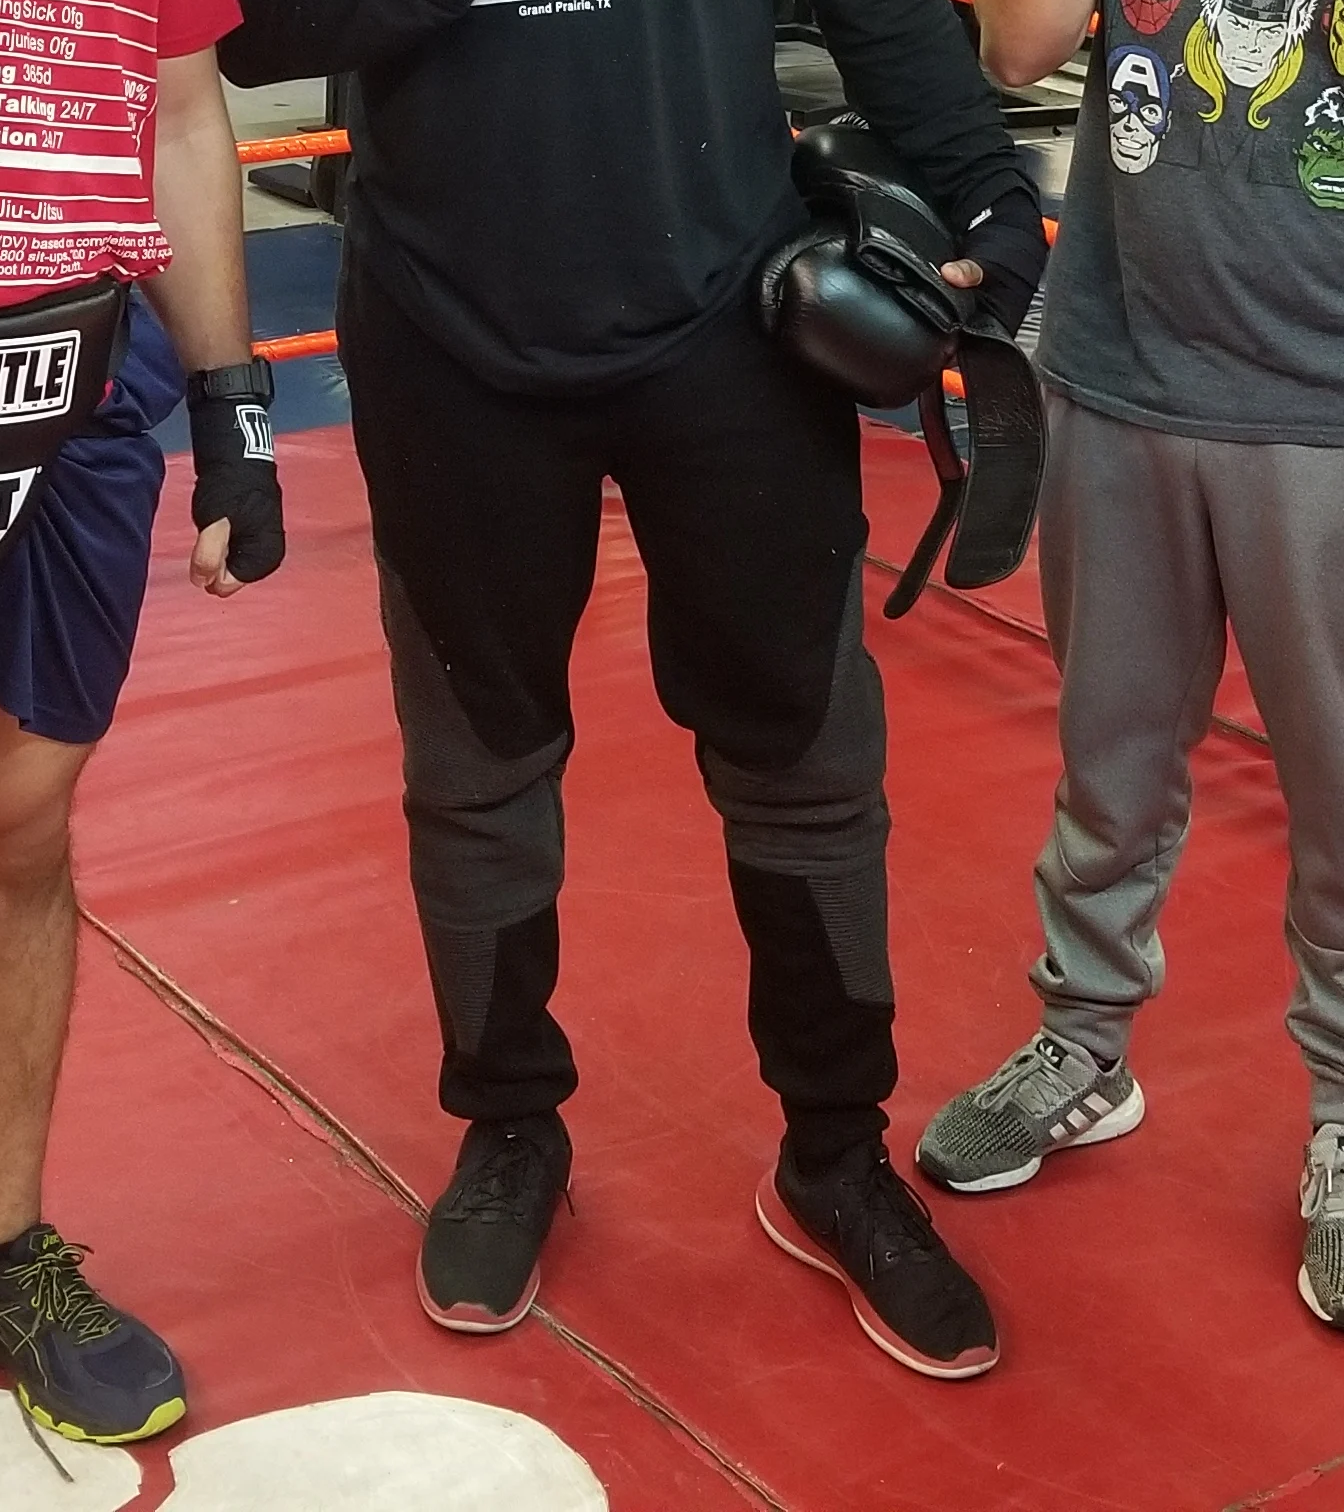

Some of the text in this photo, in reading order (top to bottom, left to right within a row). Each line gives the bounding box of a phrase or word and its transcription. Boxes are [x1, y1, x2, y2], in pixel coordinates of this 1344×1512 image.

[518, 3, 553, 17] Grand
[22, 64, 53, 87] 365d
[60, 100, 97, 121] 24/7
[41, 129, 64, 150] 24/7
[31, 236, 65, 250] based
[0, 250, 25, 263] 800
[28, 248, 71, 264] sit-ups,
[20, 262, 32, 276] in
[35, 265, 58, 278] my
[60, 260, 83, 276] butt.
